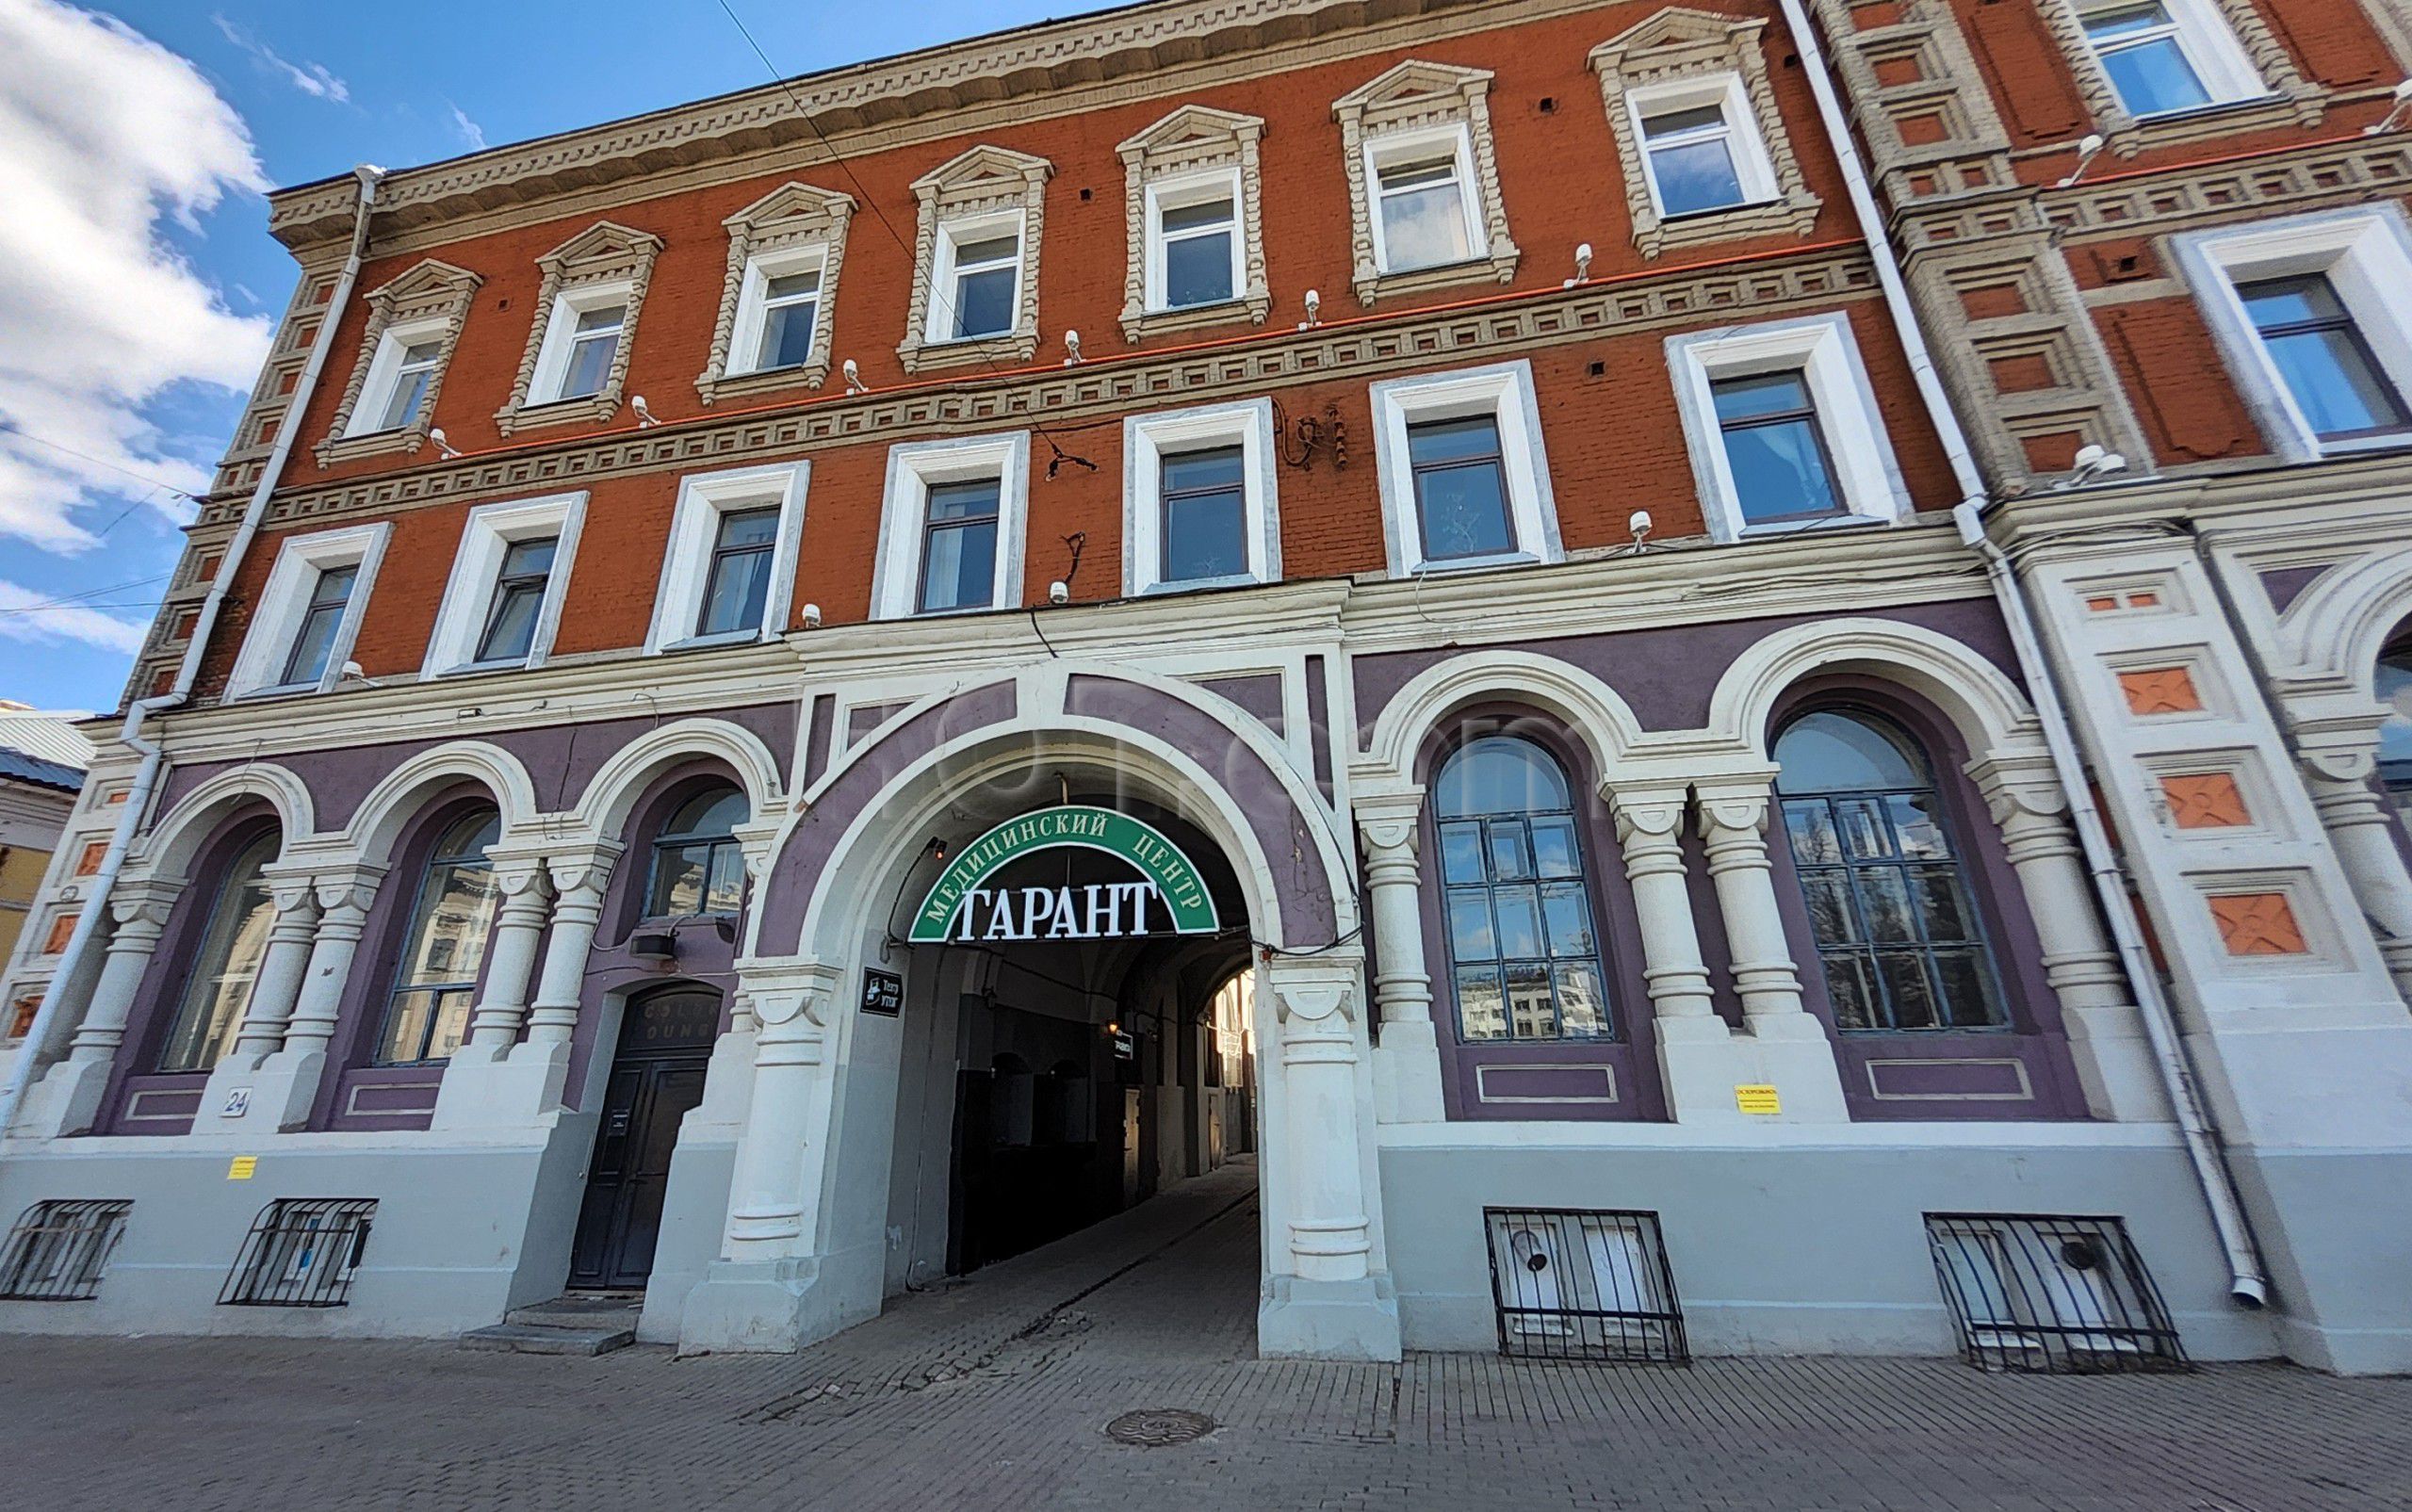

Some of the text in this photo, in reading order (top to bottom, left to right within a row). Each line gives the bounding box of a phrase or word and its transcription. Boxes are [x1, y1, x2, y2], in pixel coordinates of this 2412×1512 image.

[925, 813, 1202, 925] МЕДИЦИНСКИЙ ЦЕНТР
[956, 881, 1158, 941] ГАРАНТ
[224, 1091, 249, 1112] 24
